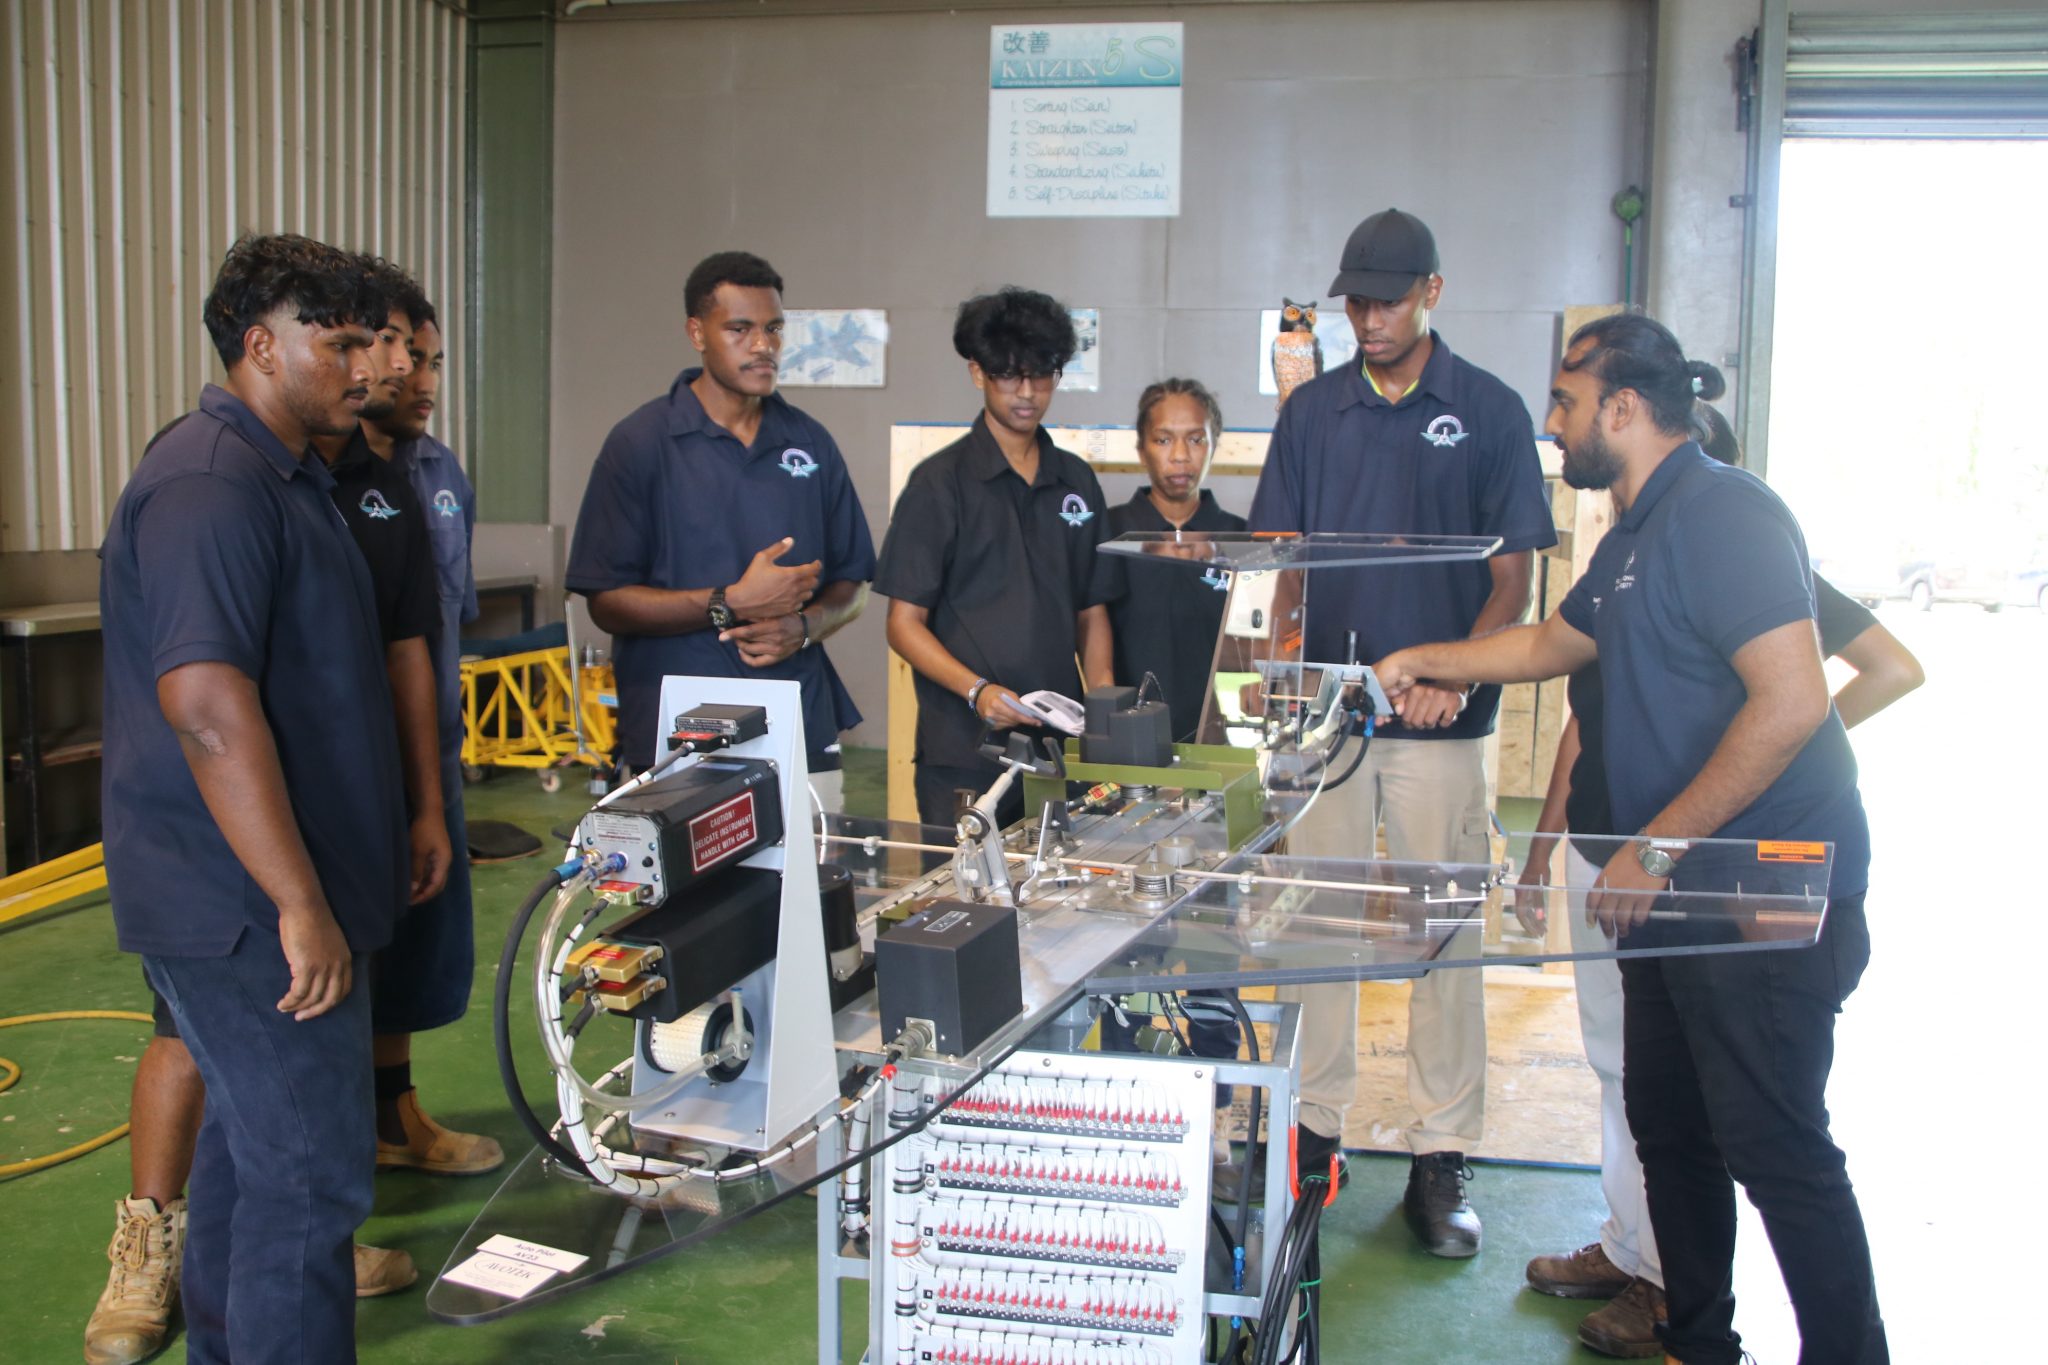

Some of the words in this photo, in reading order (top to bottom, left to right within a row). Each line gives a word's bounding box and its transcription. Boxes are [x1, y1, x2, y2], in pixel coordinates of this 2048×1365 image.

[1003, 31, 1049, 54] 改善
[1001, 59, 1099, 78] KAIZEN
[1025, 119, 1088, 137] Straighten
[1024, 163, 1109, 182] Standardizing
[1024, 185, 1119, 203] Self-Discipline
[710, 809, 736, 828] CAUTION!
[695, 831, 719, 849] DELICATE
[720, 814, 752, 837] INSTRUMENT
[700, 843, 721, 860] HANDLE
[722, 836, 736, 849] WITH
[736, 828, 750, 841] CARE
